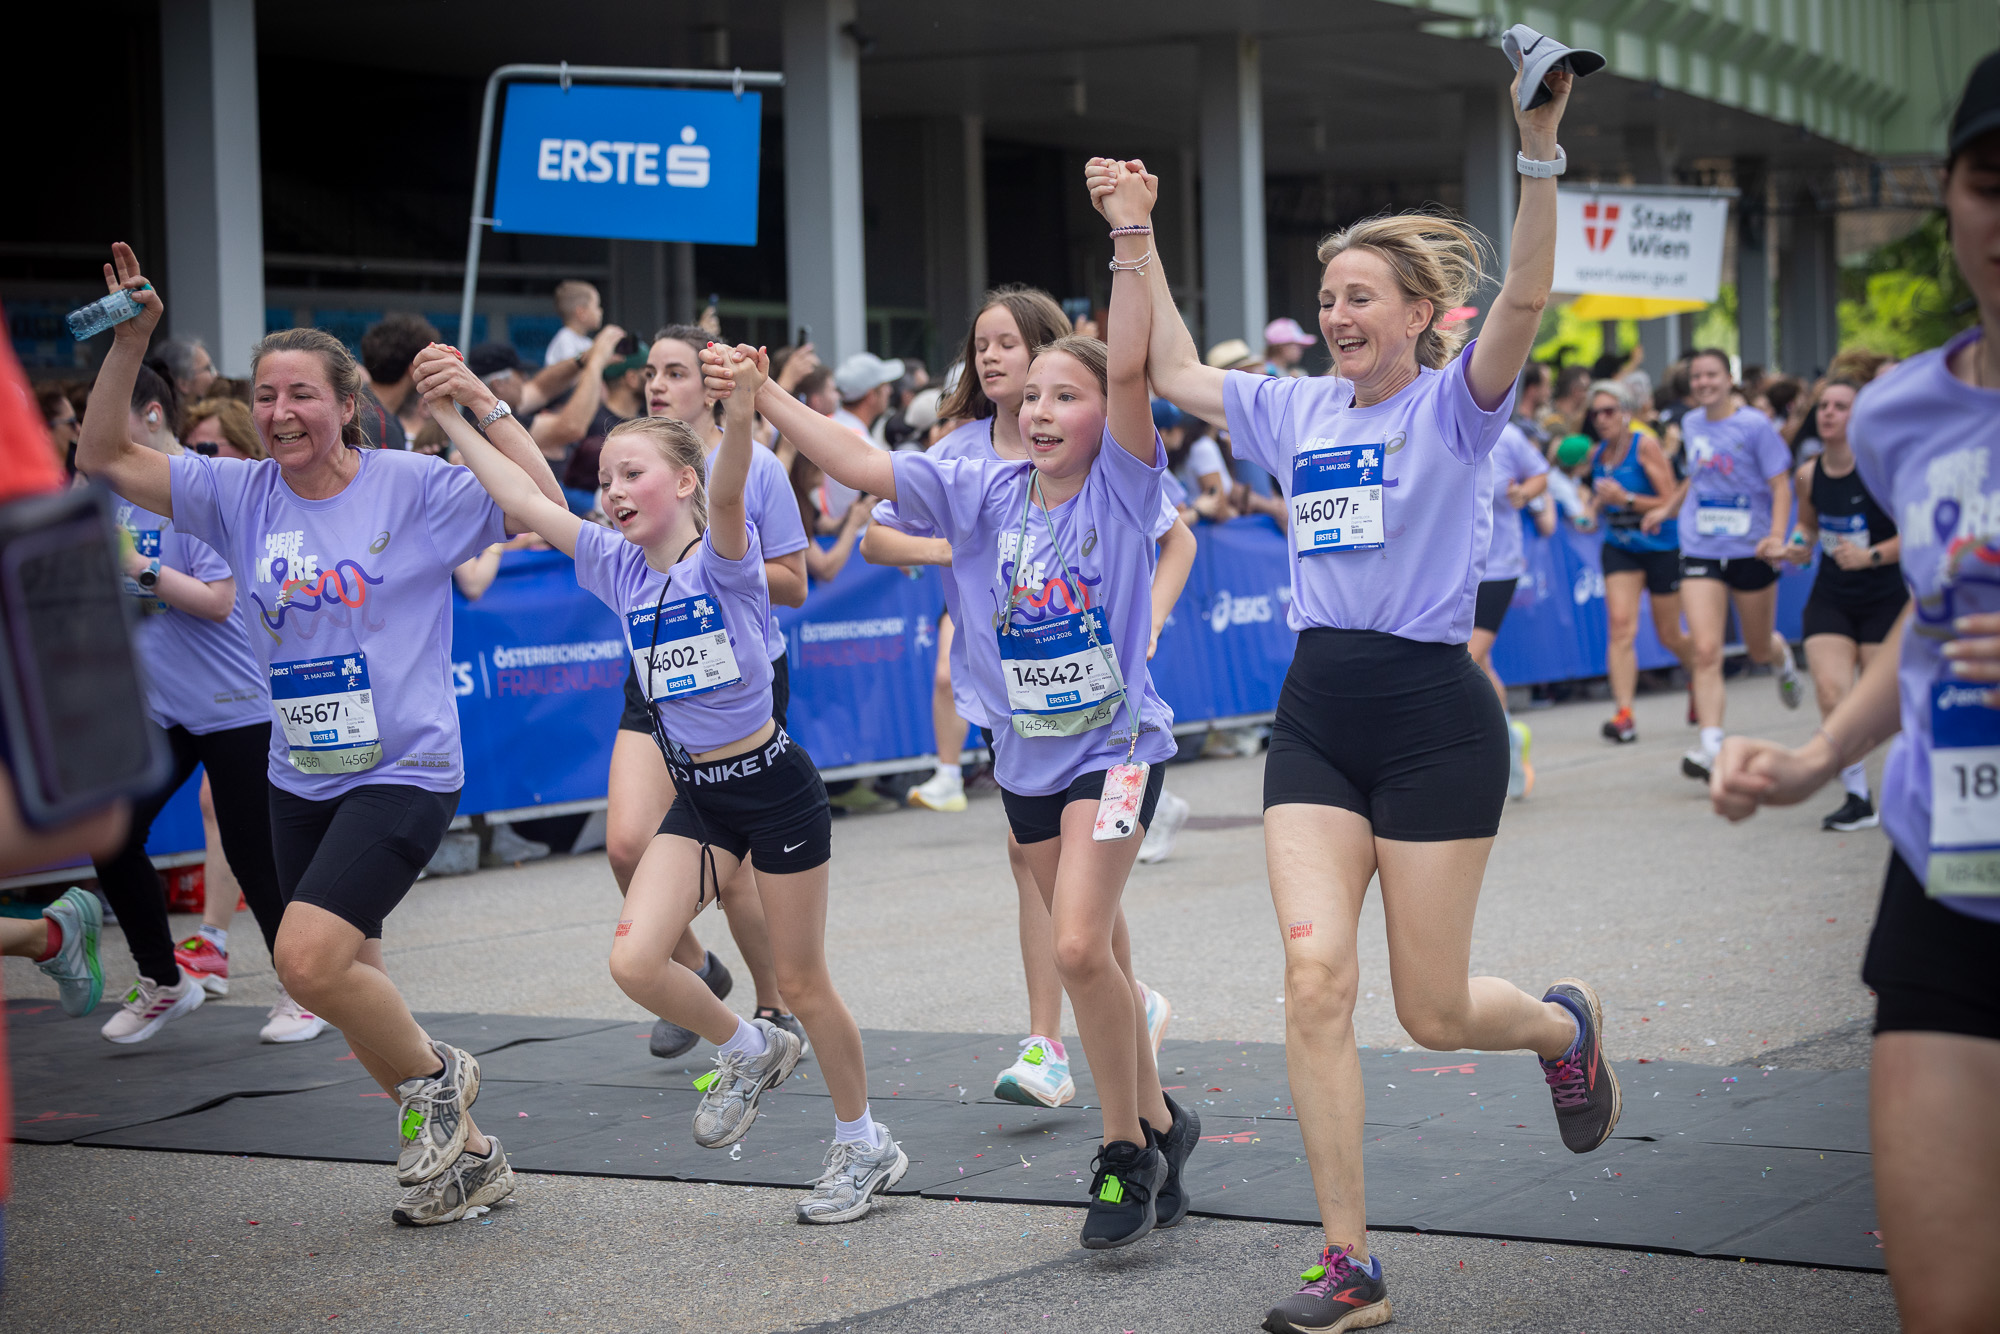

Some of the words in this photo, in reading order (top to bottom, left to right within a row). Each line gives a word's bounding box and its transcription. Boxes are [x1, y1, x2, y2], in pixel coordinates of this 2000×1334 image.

[537, 137, 660, 186] ERSTE
[1631, 204, 1693, 232] Stadt
[1628, 234, 1690, 259] Wien
[1296, 497, 1349, 526] 14607
[1352, 503, 1359, 514] F
[265, 530, 304, 550] HERE
[269, 546, 299, 562] FOR
[256, 554, 318, 586] MORE
[639, 613, 656, 623] asics
[1043, 635, 1056, 643] MAI
[1056, 631, 1072, 639] 2026
[644, 646, 699, 674] 14602
[700, 649, 708, 660] F
[274, 667, 289, 676] asics
[342, 665, 362, 676] MORE
[1013, 662, 1084, 687] 14542
[1085, 664, 1094, 674] F
[669, 679, 688, 689] ERSTE
[1049, 696, 1069, 704] ERSTE
[281, 701, 340, 725] 14567
[1020, 720, 1059, 731] 14542
[340, 752, 375, 766] 14567
[694, 755, 762, 786] NIKE
[1289, 930, 1313, 941] POWER!
[1290, 923, 1313, 934] FEMALE
